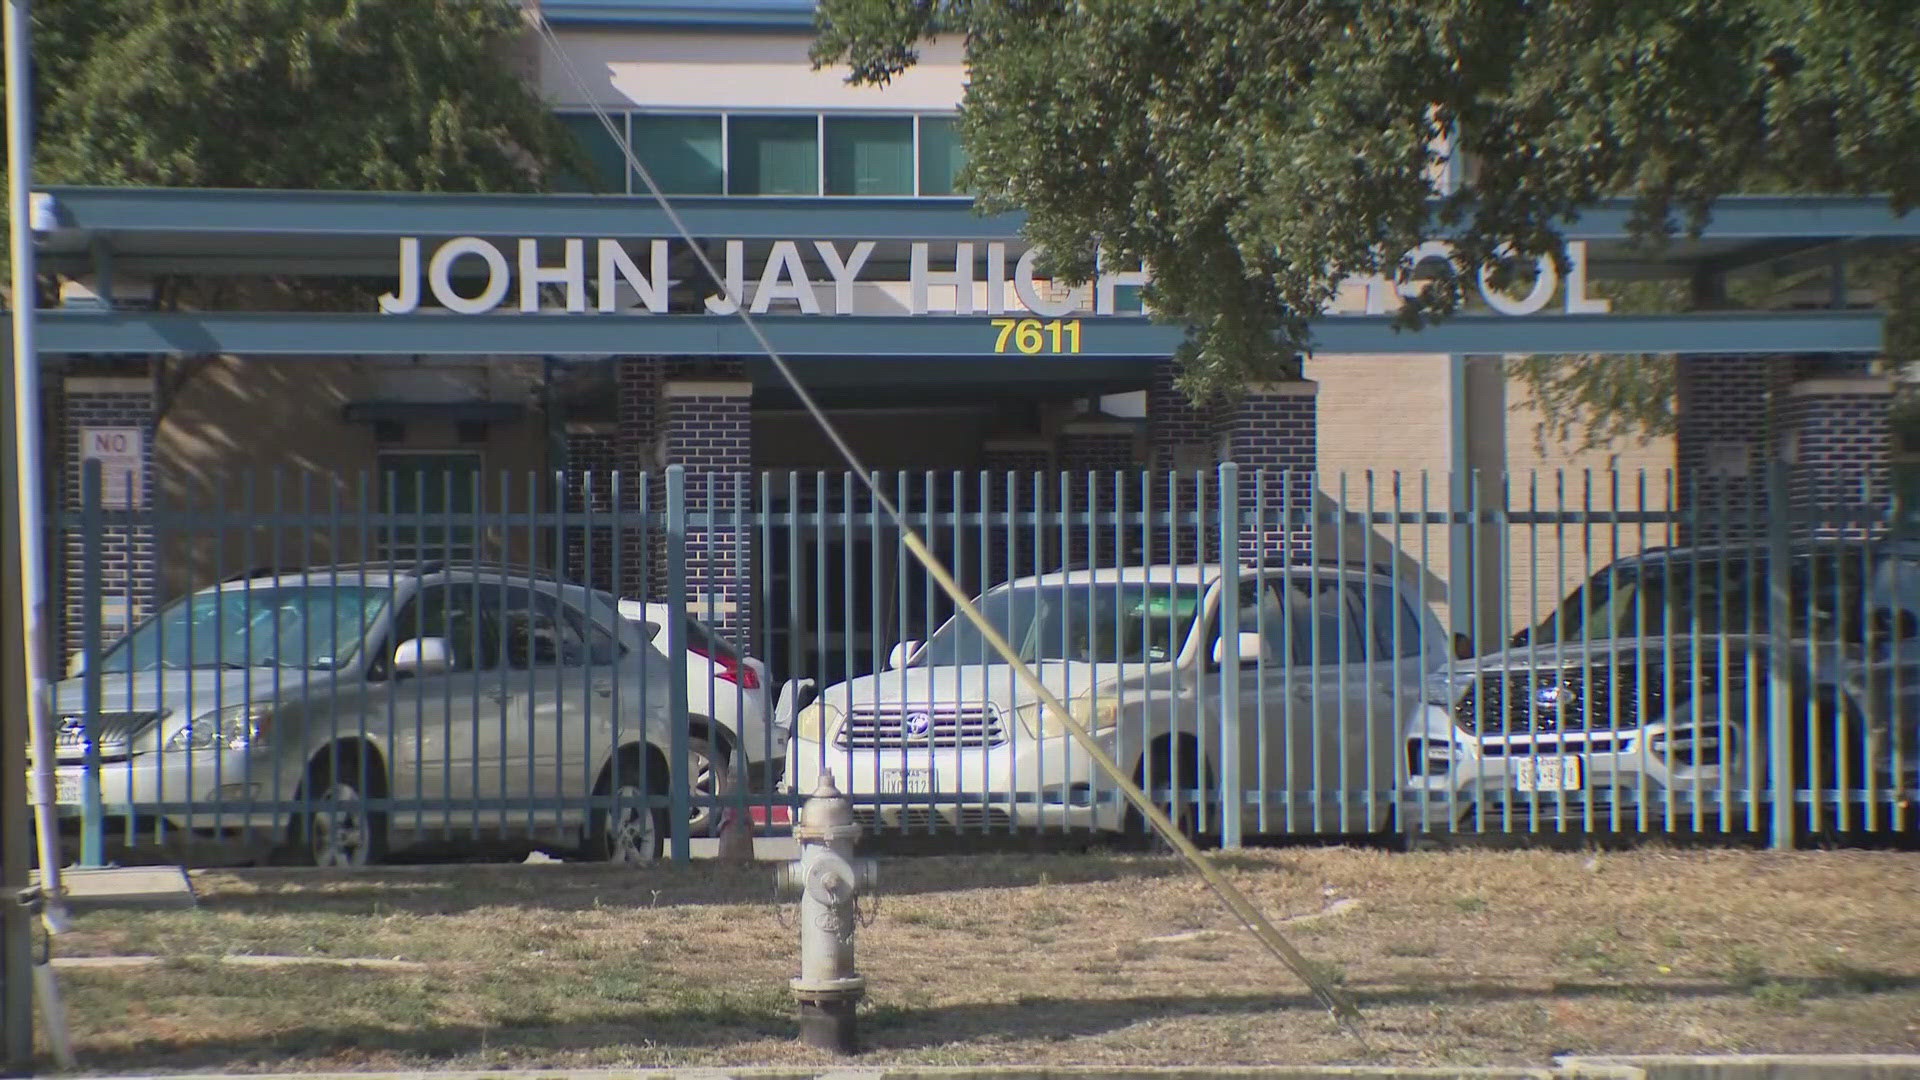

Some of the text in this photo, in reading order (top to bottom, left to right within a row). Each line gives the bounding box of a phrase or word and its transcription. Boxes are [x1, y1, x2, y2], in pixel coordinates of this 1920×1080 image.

[378, 236, 670, 315] JOHN
[703, 240, 876, 316] JAY
[990, 319, 1081, 354] 7611
[94, 433, 128, 453] NO
